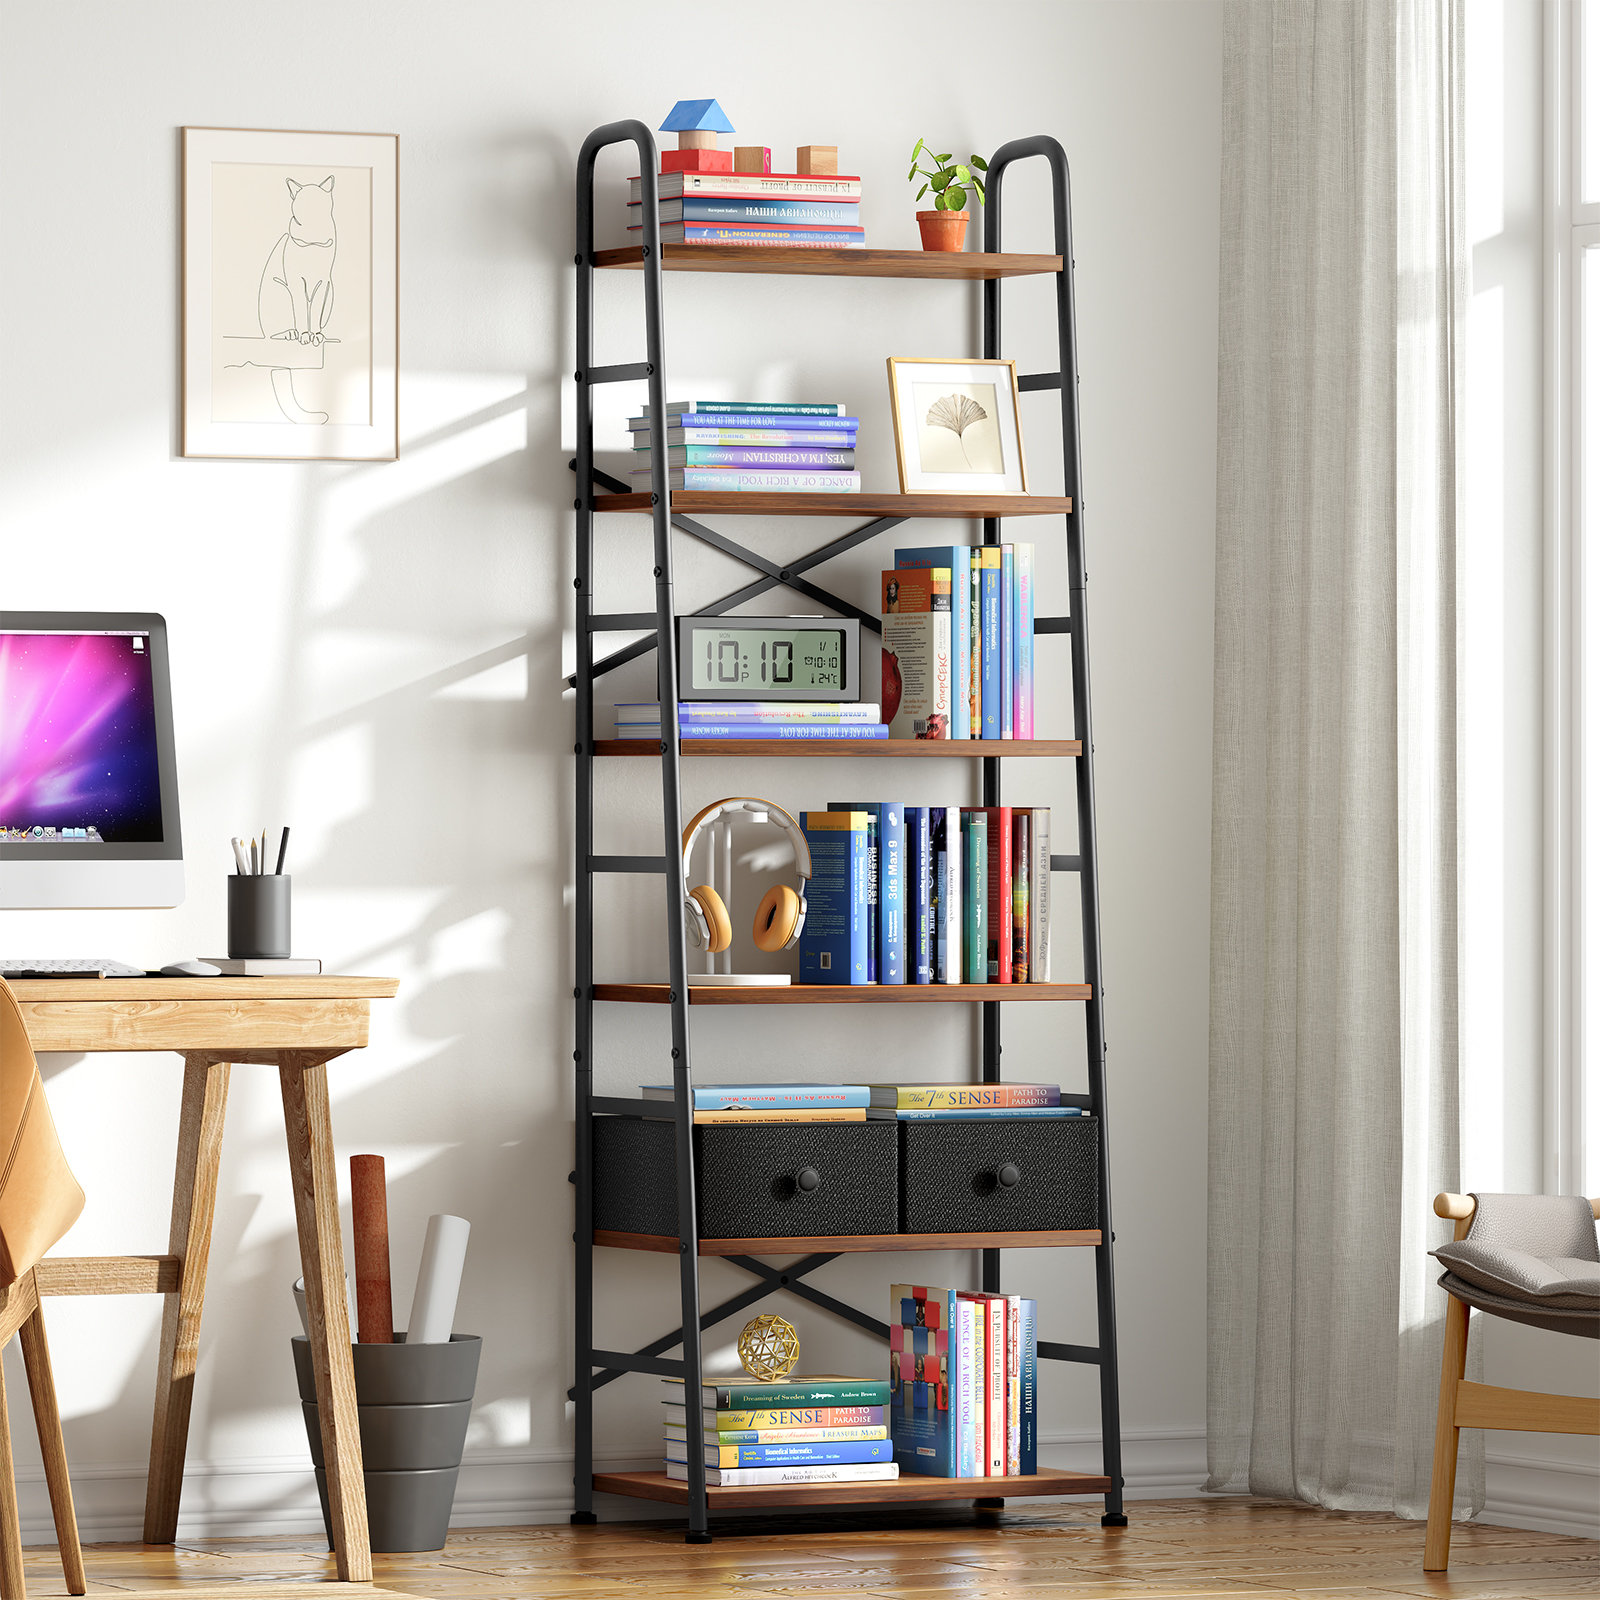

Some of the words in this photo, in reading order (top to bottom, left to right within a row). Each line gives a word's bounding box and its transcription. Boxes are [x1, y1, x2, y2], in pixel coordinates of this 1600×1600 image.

[760, 181, 789, 191] PROFIT
[805, 183, 838, 192] PURSUIT
[745, 207, 777, 216] НАШИ
[779, 208, 844, 220] АВИАНОСЦЫ
[693, 416, 706, 424] YOU
[706, 416, 716, 424] ARE
[717, 416, 724, 424] AT
[725, 416, 736, 425] THE
[736, 416, 750, 425] TIME
[751, 417, 762, 425] FOR
[762, 417, 776, 426] LOVE
[707, 453, 733, 461] Moore
[742, 452, 799, 464] CHRISTIAN!
[801, 453, 807, 464] A
[808, 453, 823, 464] I'M
[825, 453, 846, 464] YES,
[737, 476, 763, 486] YOGI
[766, 477, 789, 486] RICH
[792, 477, 800, 486] A
[802, 477, 816, 486] OF
[819, 477, 853, 487] DANCE
[960, 608, 966, 620] As
[706, 640, 793, 683] 10:10
[813, 656, 838, 669] 10:10
[741, 671, 749, 683] P
[779, 727, 796, 738] LOVE
[796, 728, 809, 738] FOR
[810, 728, 826, 738] TIME
[827, 728, 840, 738] THE
[840, 728, 848, 738] AT
[849, 728, 861, 738] ARE
[862, 728, 875, 738] YOU
[887, 839, 898, 848] 9
[887, 849, 898, 876] Max
[1039, 845, 1047, 870] АЗИИ
[887, 878, 898, 901] 3ds
[1037, 873, 1047, 914] СРЕДНЕЙ
[908, 1094, 925, 1102] The
[925, 1089, 945, 1107] 7th
[948, 1091, 1001, 1105] SENSE
[962, 1310, 970, 1344] DANCE
[975, 1336, 983, 1345] the
[992, 1322, 1001, 1356] PURSUIT
[1024, 1315, 1034, 1380] АВИАНОСЦЫ
[962, 1346, 970, 1361] OF
[962, 1363, 970, 1371] A
[975, 1347, 984, 1384] CORPORATE
[995, 1358, 1001, 1369] OF
[962, 1373, 970, 1397] RICH
[992, 1372, 1001, 1400] PROFIT
[781, 1393, 805, 1401] Sweden
[975, 1386, 984, 1404] BELLY
[1025, 1382, 1033, 1414] НАШИ
[962, 1400, 970, 1425] YOGI
[728, 1413, 745, 1423] The
[746, 1409, 765, 1428] 7th
[769, 1410, 823, 1425] SENSE
[833, 1416, 872, 1424] PARADISE
[822, 1430, 858, 1438] TREASURE
[975, 1422, 984, 1435] Tom
[788, 1447, 813, 1455] Informatics
[975, 1435, 984, 1463] FitzGerald
[961, 1442, 969, 1471] Beckley
